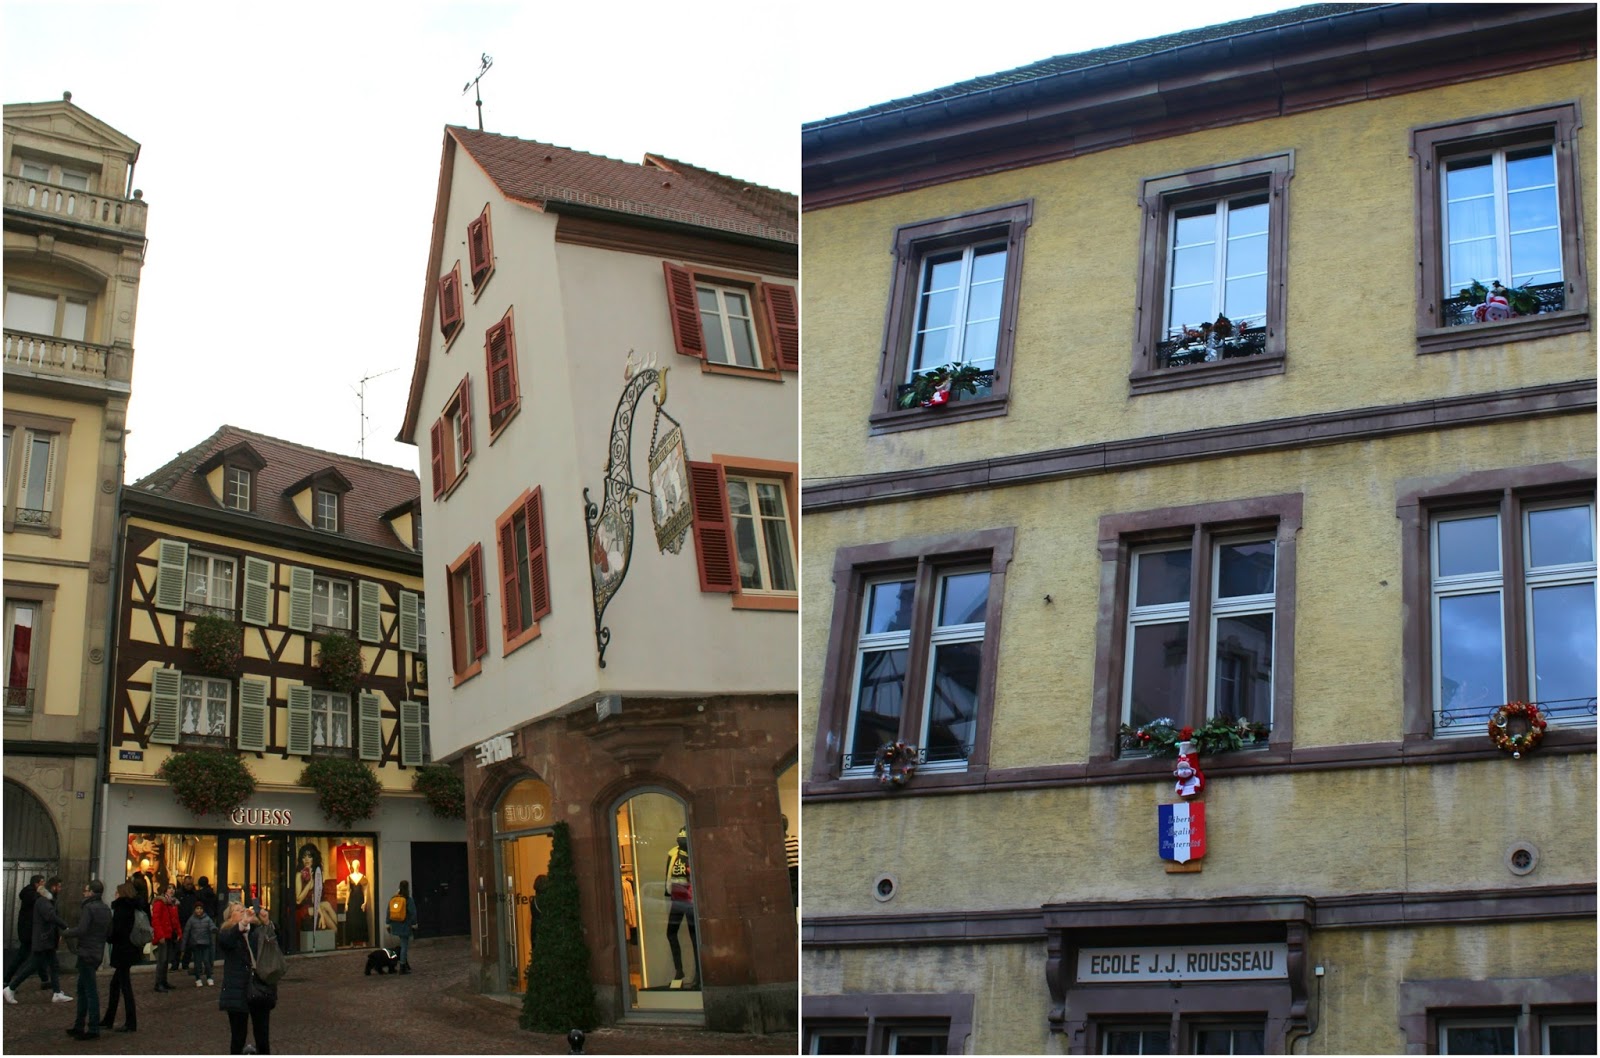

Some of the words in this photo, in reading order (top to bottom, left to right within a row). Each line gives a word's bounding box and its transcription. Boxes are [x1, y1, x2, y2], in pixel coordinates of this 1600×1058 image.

[231, 807, 293, 826] GUESS
[1090, 954, 1140, 975] ECOLE
[1148, 953, 1180, 974] J.J.
[1186, 950, 1274, 973] ROUSSEAU
